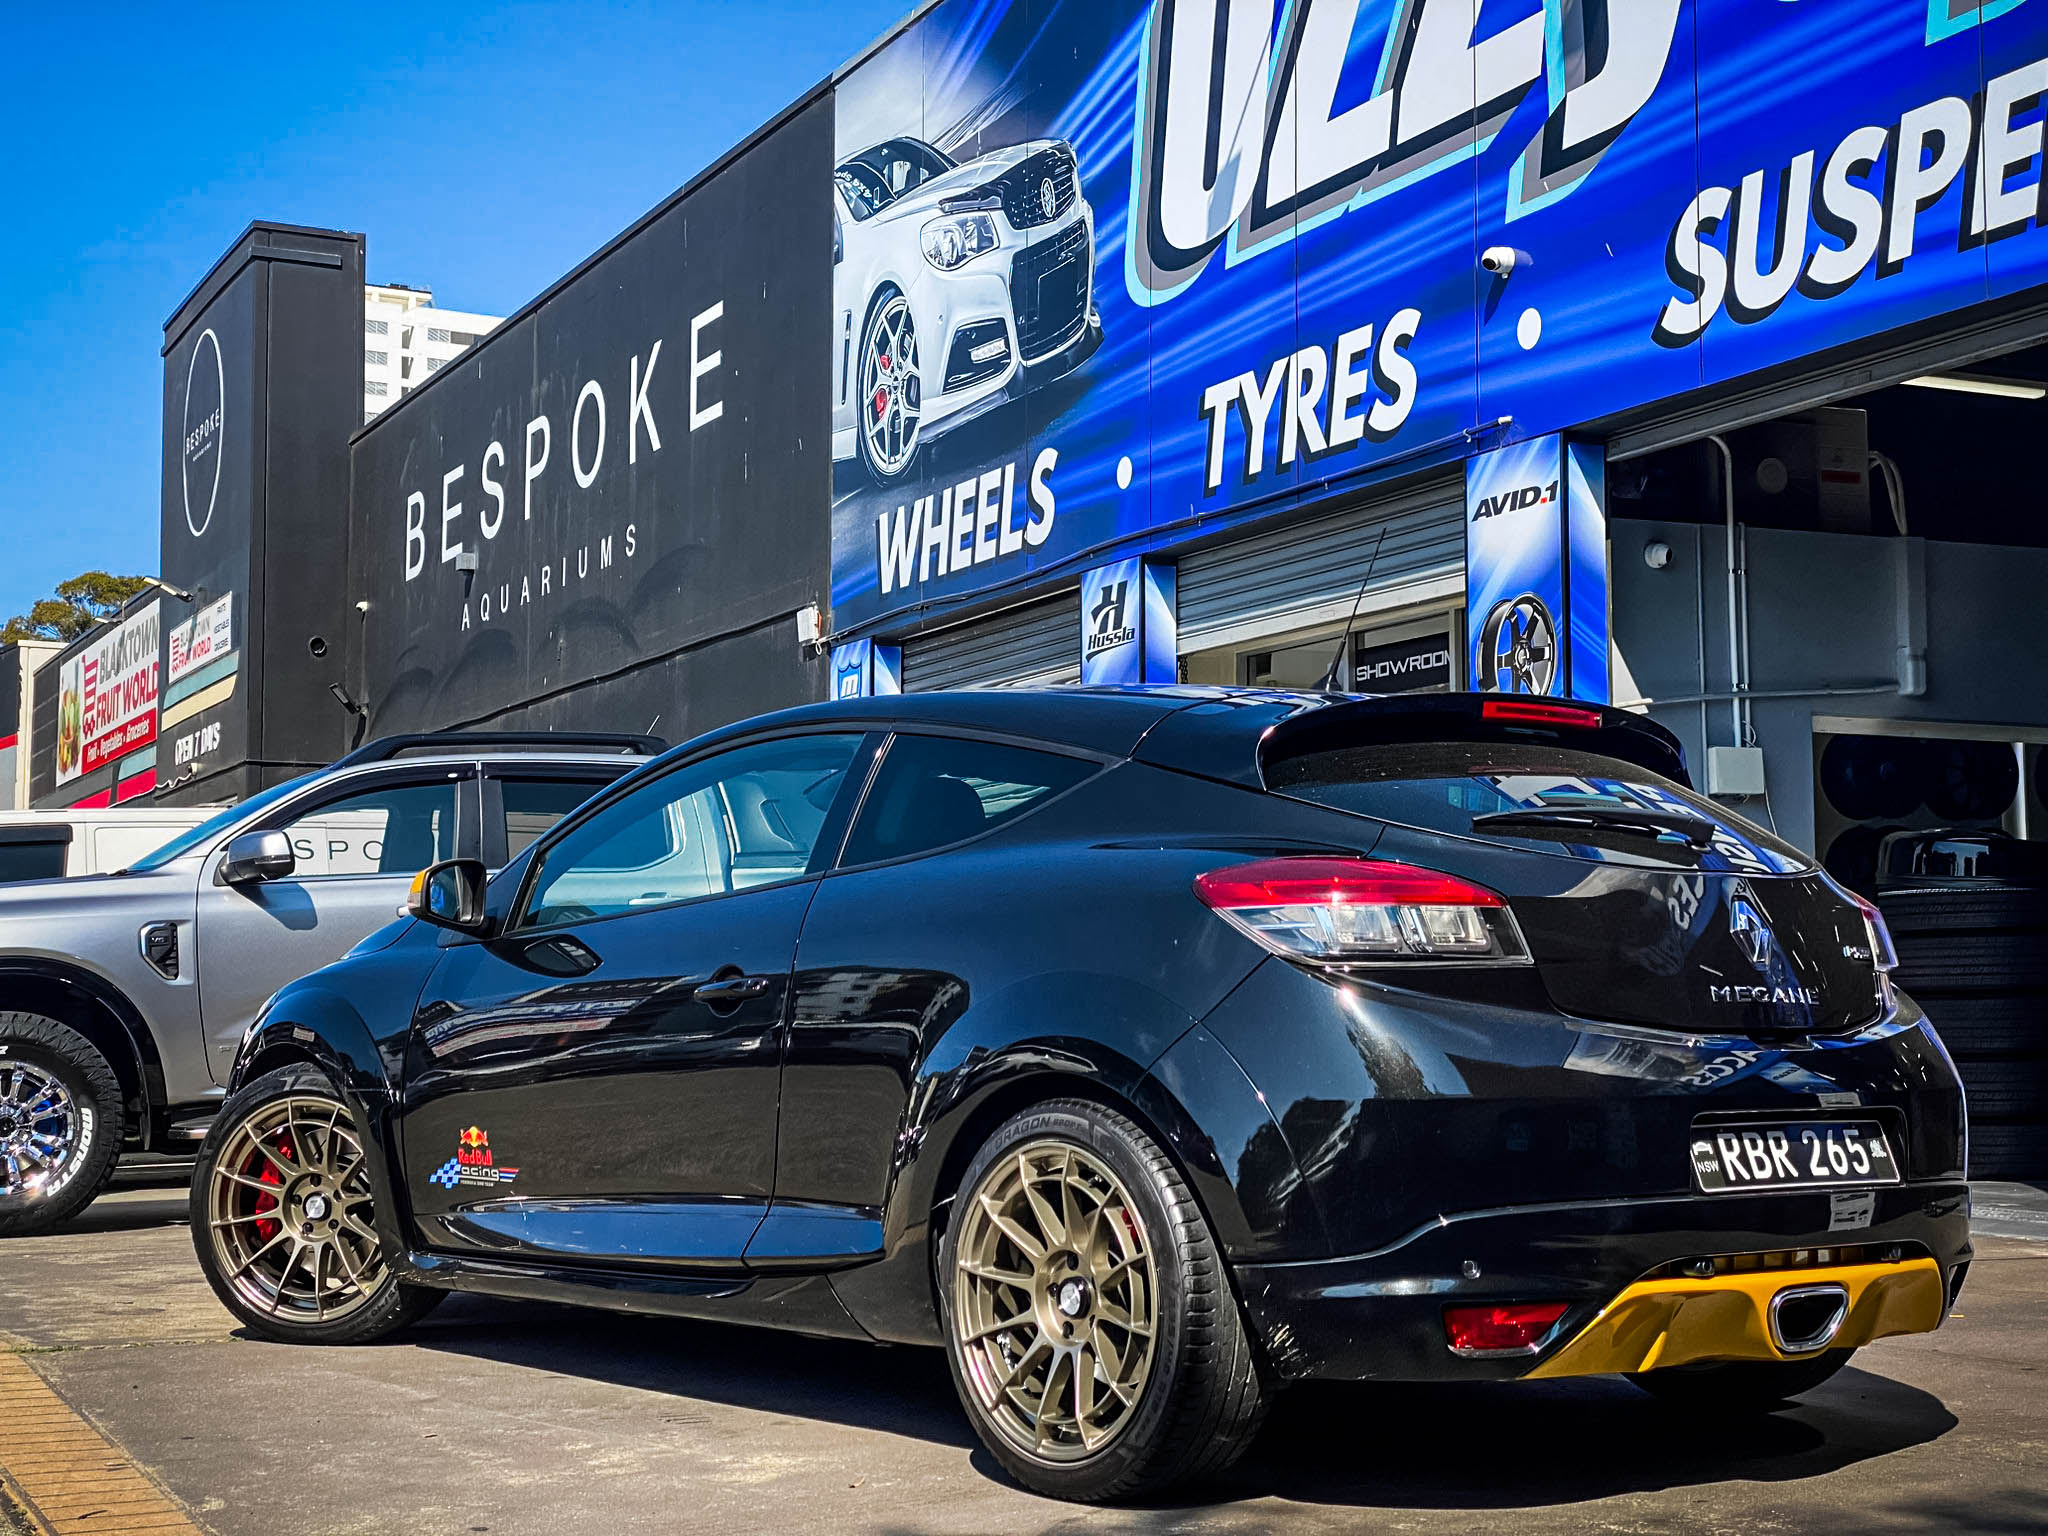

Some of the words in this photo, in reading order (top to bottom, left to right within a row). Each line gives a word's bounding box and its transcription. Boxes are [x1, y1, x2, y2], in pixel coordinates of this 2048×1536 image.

[186, 408, 219, 455] BESPOKE
[1203, 308, 1421, 489] TYRES
[405, 300, 724, 583] BESPOKE
[879, 447, 1059, 595] WHEELS
[461, 524, 636, 631] AQUARIUMS
[1087, 626, 1135, 651] Hussla
[96, 683, 121, 730] FRUIT
[122, 661, 160, 715] WORLD
[1697, 1160, 1719, 1173] NSW
[1716, 1130, 1799, 1181] RBR
[1801, 1129, 1871, 1176] 265
